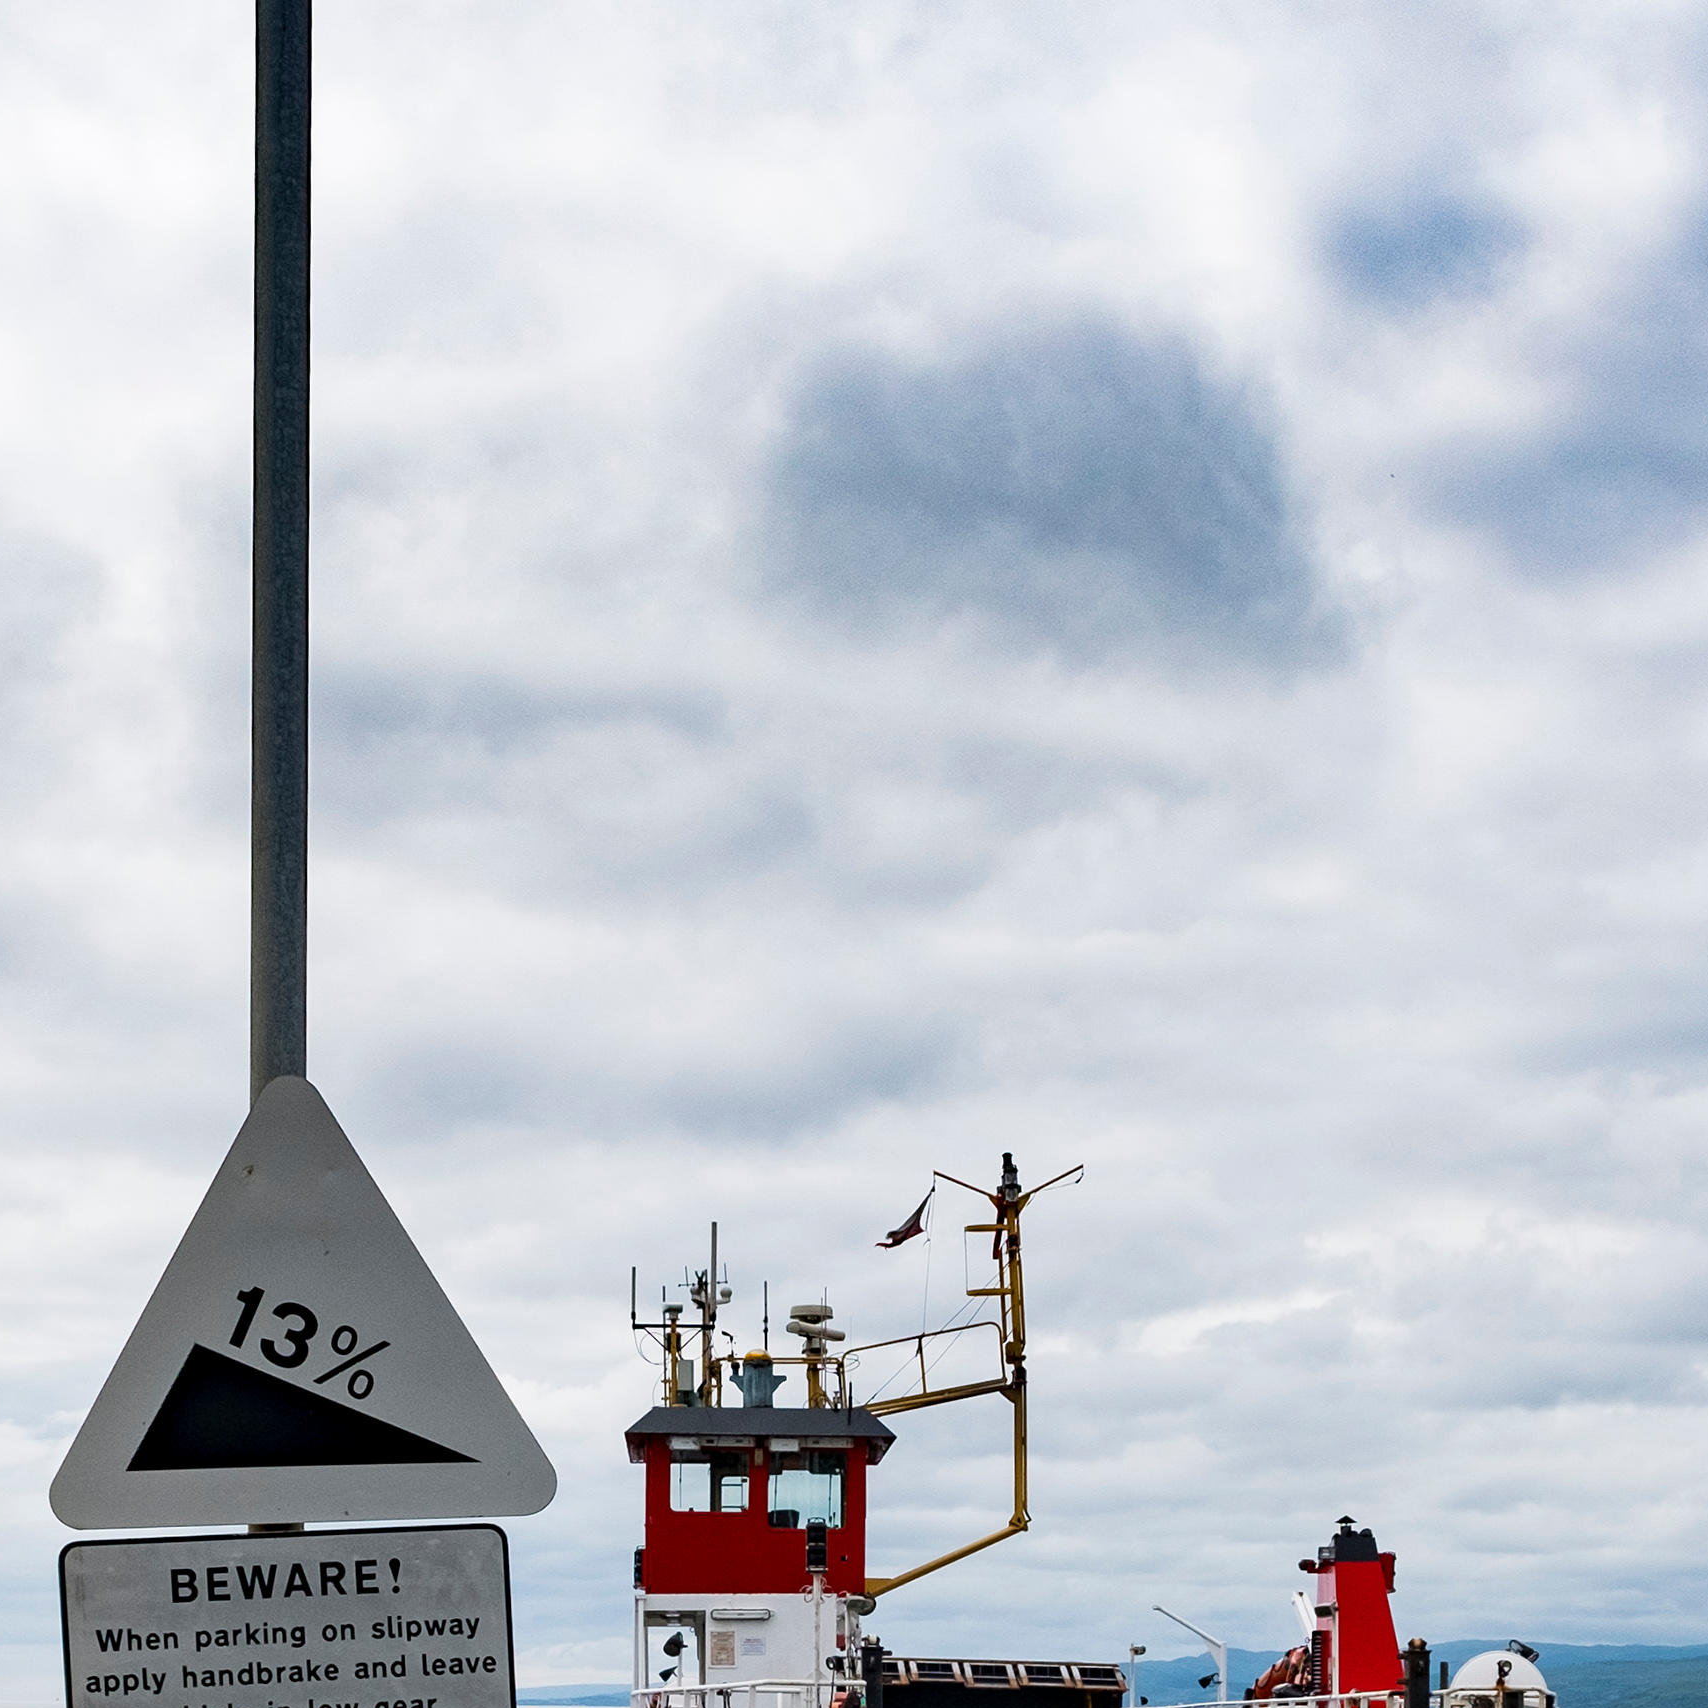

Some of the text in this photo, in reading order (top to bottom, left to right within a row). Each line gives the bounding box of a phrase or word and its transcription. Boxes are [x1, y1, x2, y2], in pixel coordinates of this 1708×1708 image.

[229, 1287, 390, 1399] 13%
[171, 1558, 400, 1603] BEWARE!
[96, 1616, 479, 1652] When parking on slipway
[86, 1654, 496, 1696] apply handbrake and leave
